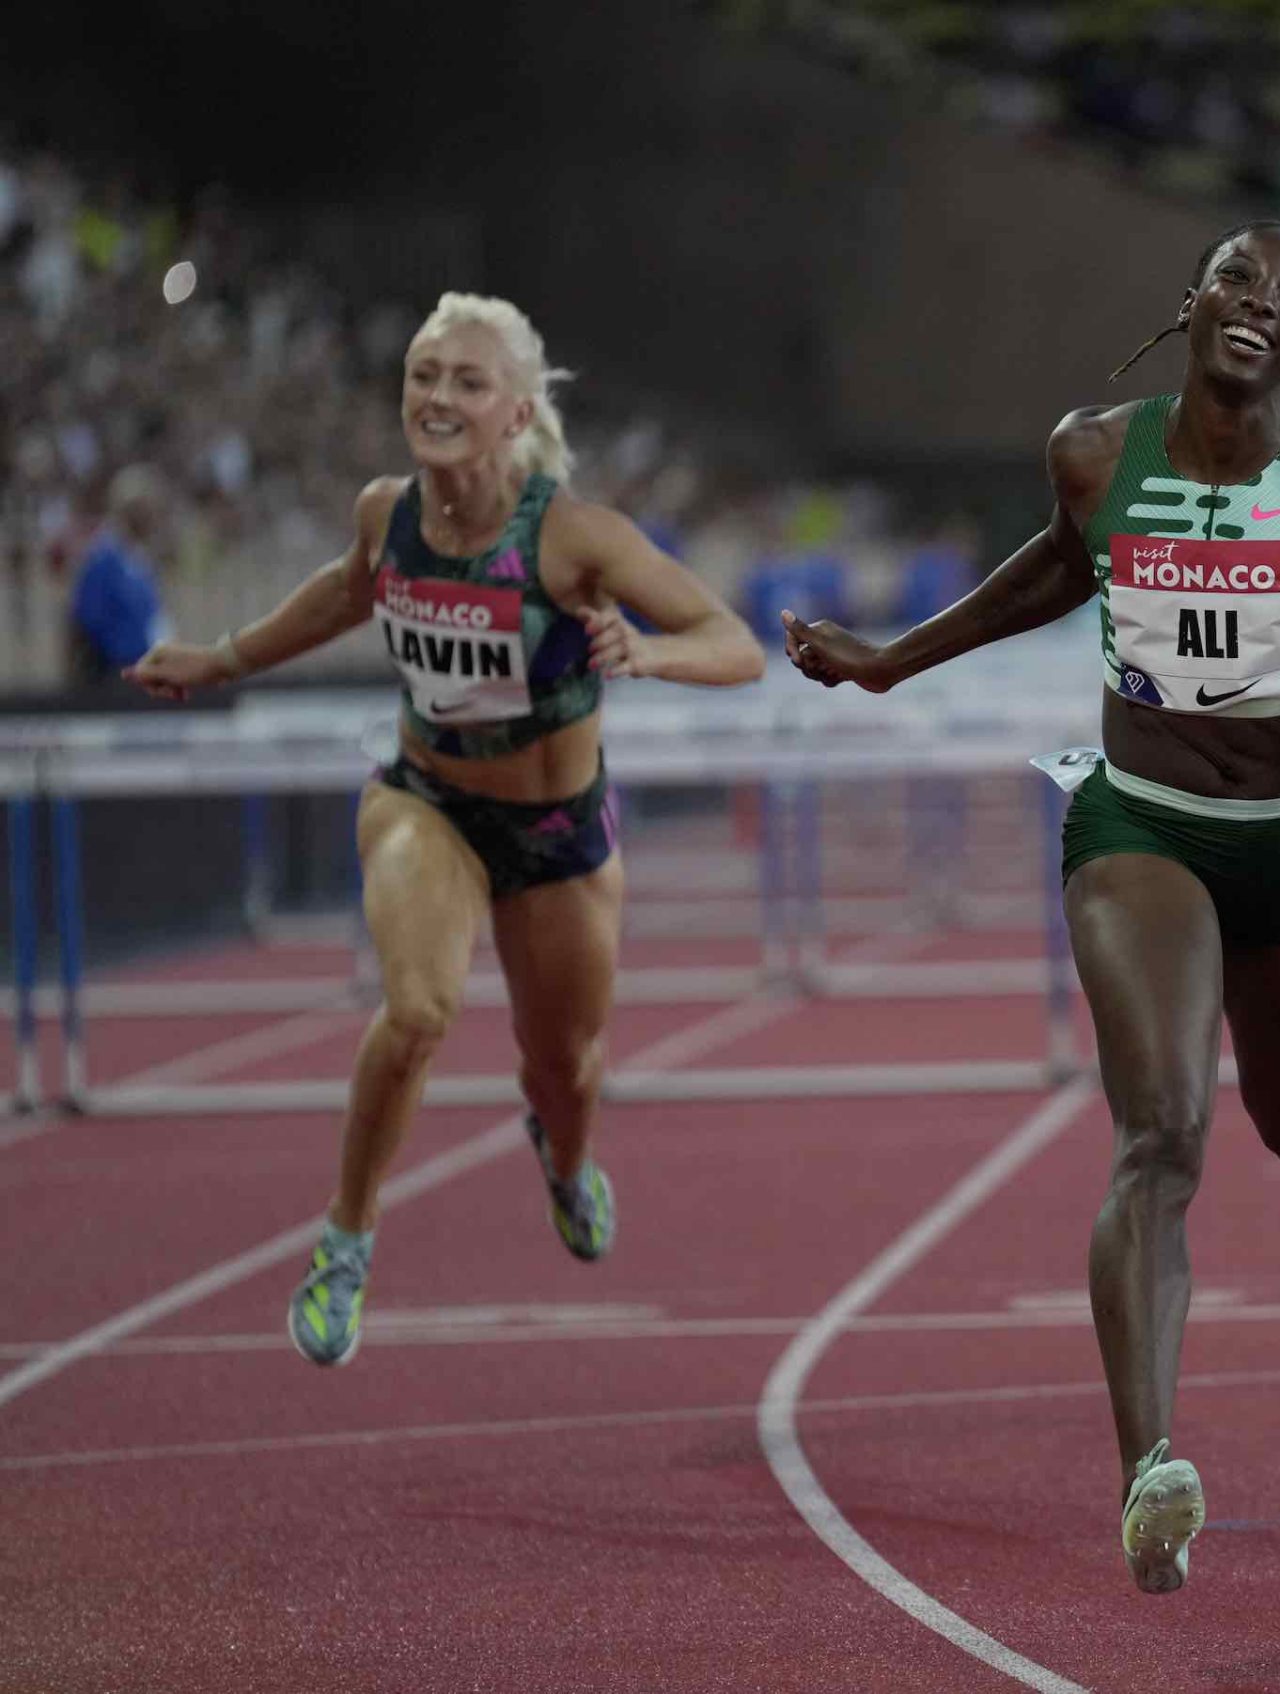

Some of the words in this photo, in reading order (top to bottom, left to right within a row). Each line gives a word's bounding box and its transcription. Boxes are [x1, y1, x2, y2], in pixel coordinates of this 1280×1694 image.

[1132, 540, 1180, 560] visit
[1133, 561, 1276, 590] MONACO
[1177, 609, 1239, 659] ALI
